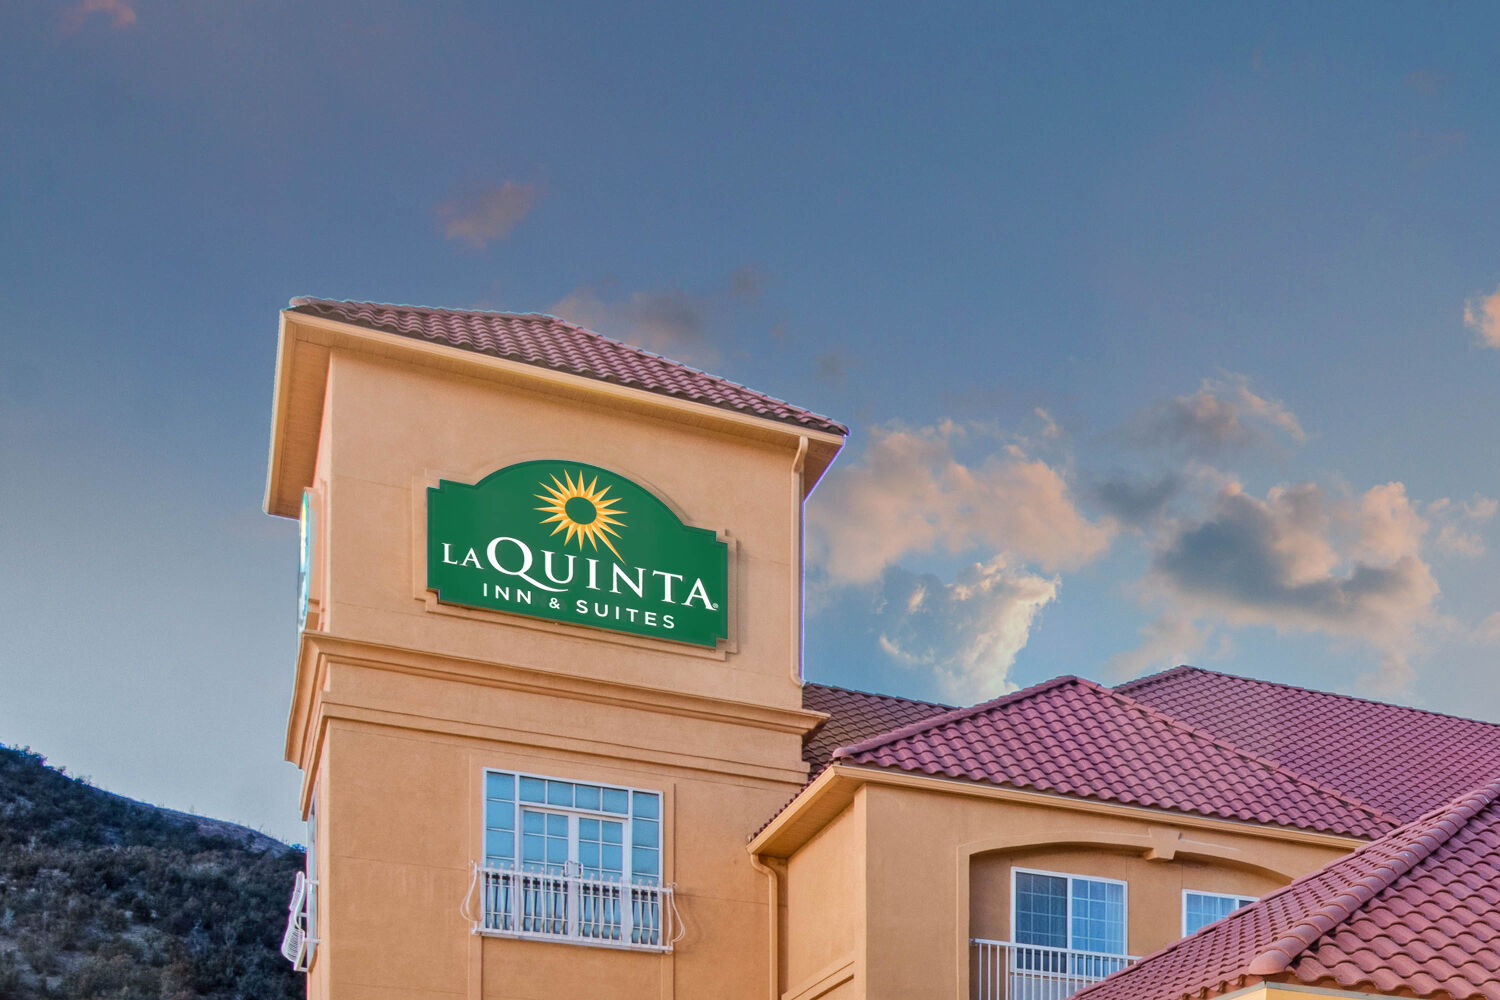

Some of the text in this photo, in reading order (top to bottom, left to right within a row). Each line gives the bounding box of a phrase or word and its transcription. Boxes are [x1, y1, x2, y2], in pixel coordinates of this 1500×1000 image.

[442, 536, 718, 611] LA QUINTA
[483, 582, 675, 629] INN & SUITES
